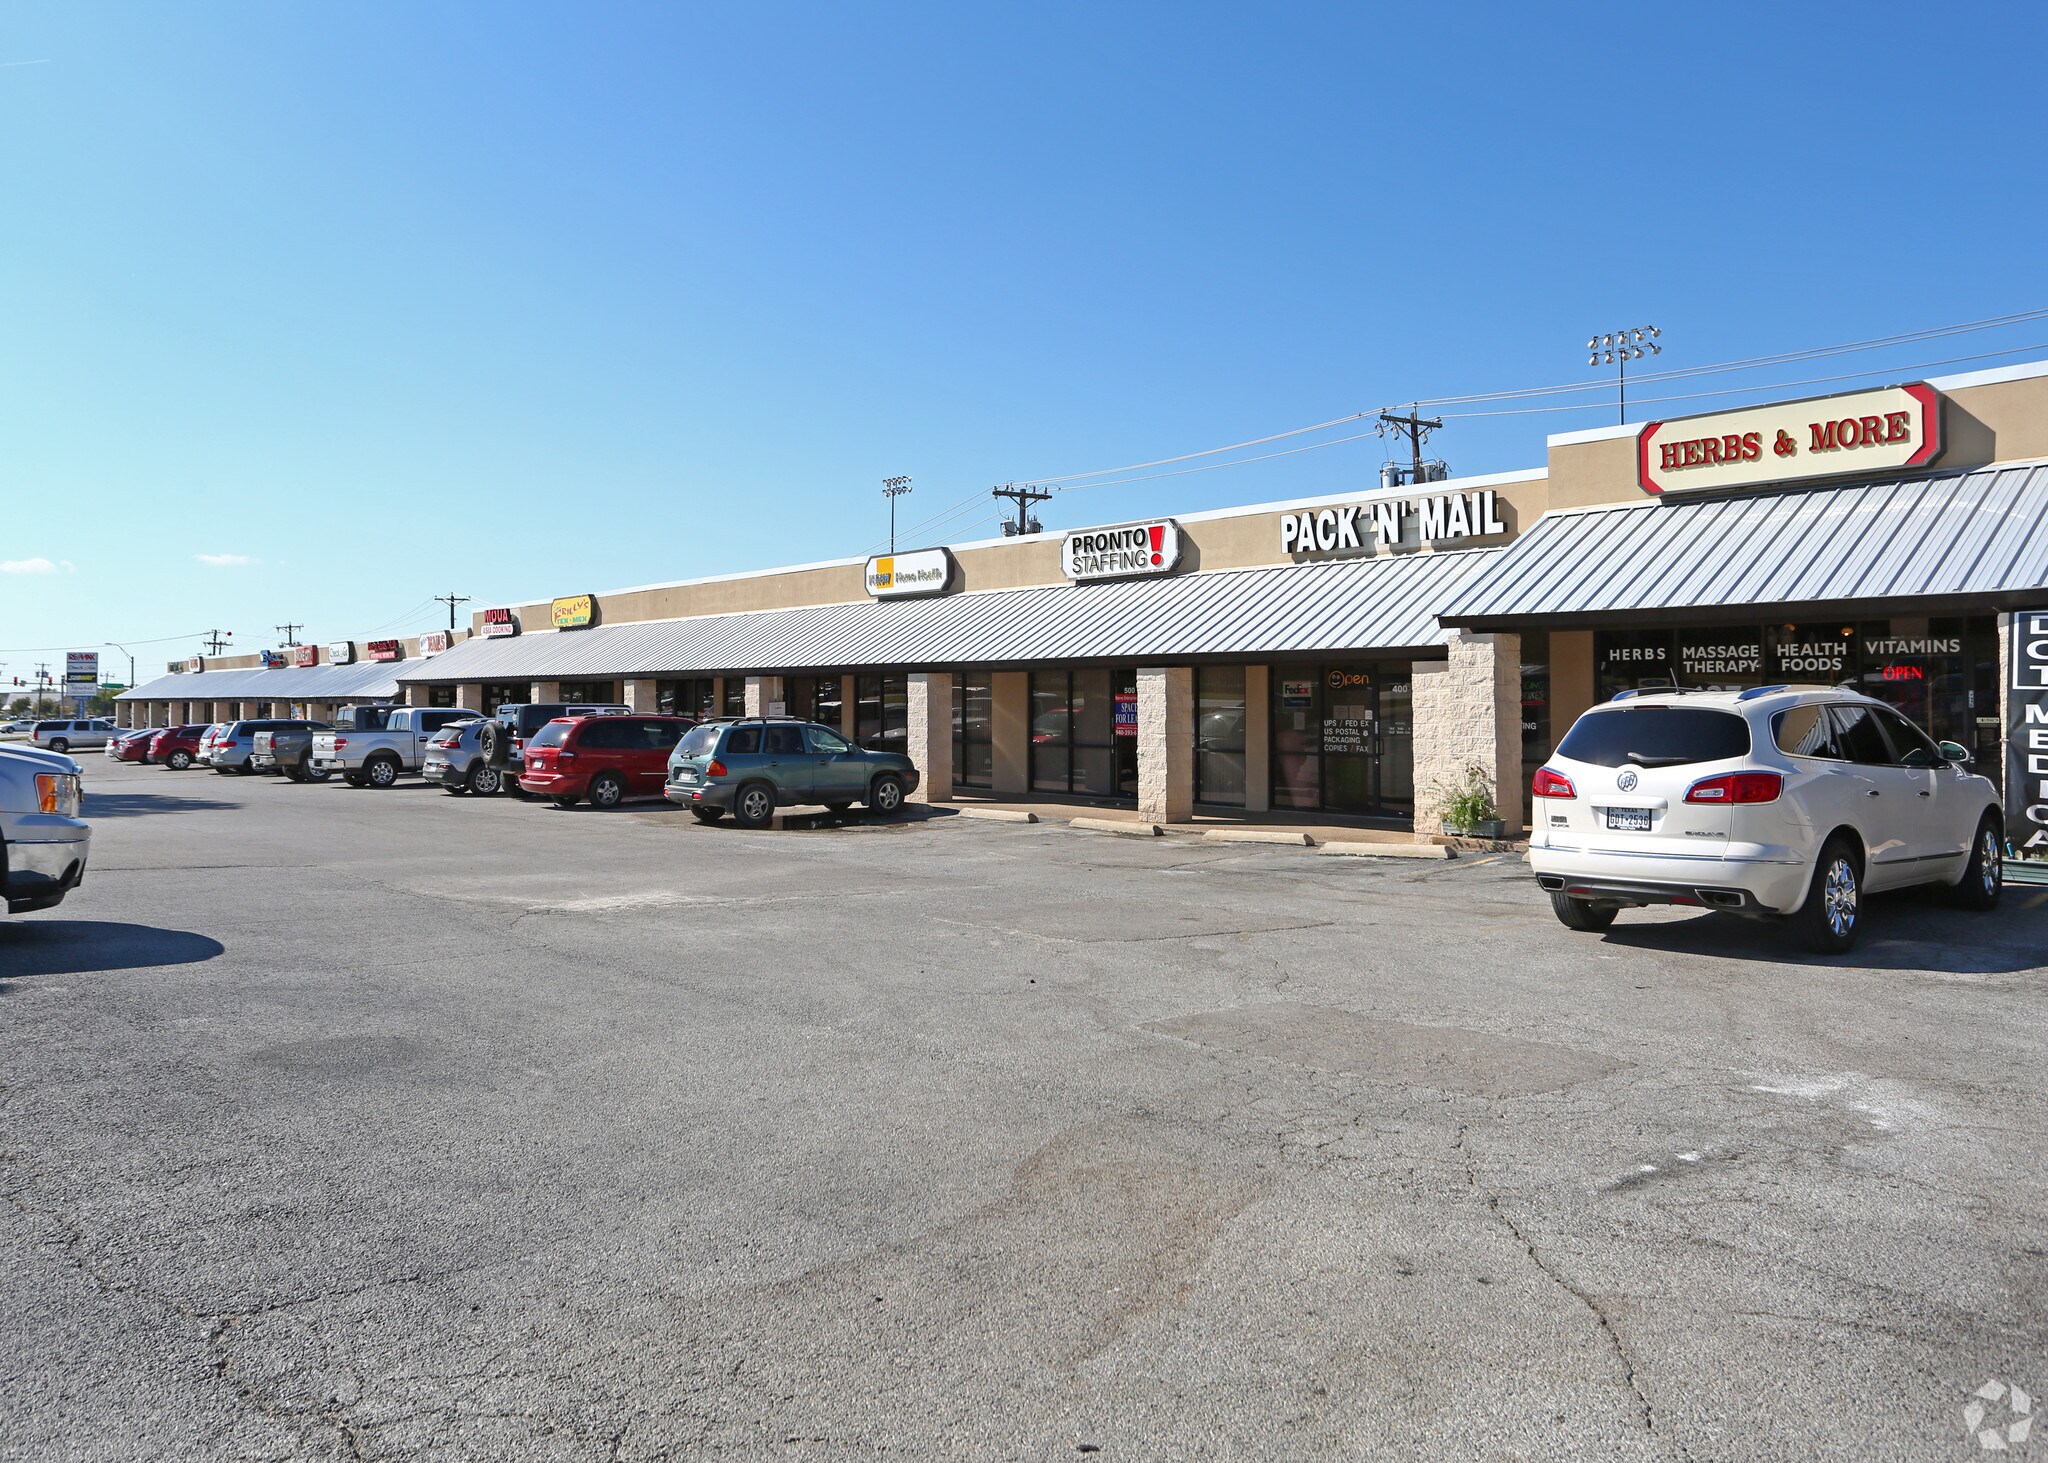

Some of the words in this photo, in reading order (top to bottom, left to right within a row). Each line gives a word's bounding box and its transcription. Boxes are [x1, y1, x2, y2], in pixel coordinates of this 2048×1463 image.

[1659, 432, 1762, 471] HERBS
[1773, 428, 1798, 458] &
[1808, 410, 1911, 453] MORE
[1280, 506, 1361, 554] PACK
[1418, 490, 1507, 541] MAIL
[1072, 550, 1148, 575] STAFFING
[484, 608, 510, 623] MOUA
[492, 625, 511, 634] COOKING
[1609, 647, 1667, 662] HERBS
[1682, 644, 1760, 659] MASSAGE
[1776, 642, 1847, 657] HEALTH
[1865, 639, 1961, 655] VITAMINS
[1683, 659, 1760, 674] THERAPY
[1781, 657, 1843, 672] FOODS
[1328, 670, 1370, 689] Open
[1882, 664, 1923, 681] OPEN
[1284, 684, 1309, 695] FedEx
[1392, 685, 1408, 693] 400
[1115, 713, 1127, 724] FOR
[1323, 719, 1337, 727] UPS
[1345, 719, 1359, 727] FED
[1360, 719, 1370, 727] EX
[1323, 736, 1361, 744] PACKAGING
[1323, 744, 1348, 752] COPIES
[1355, 745, 1369, 753] FAX
